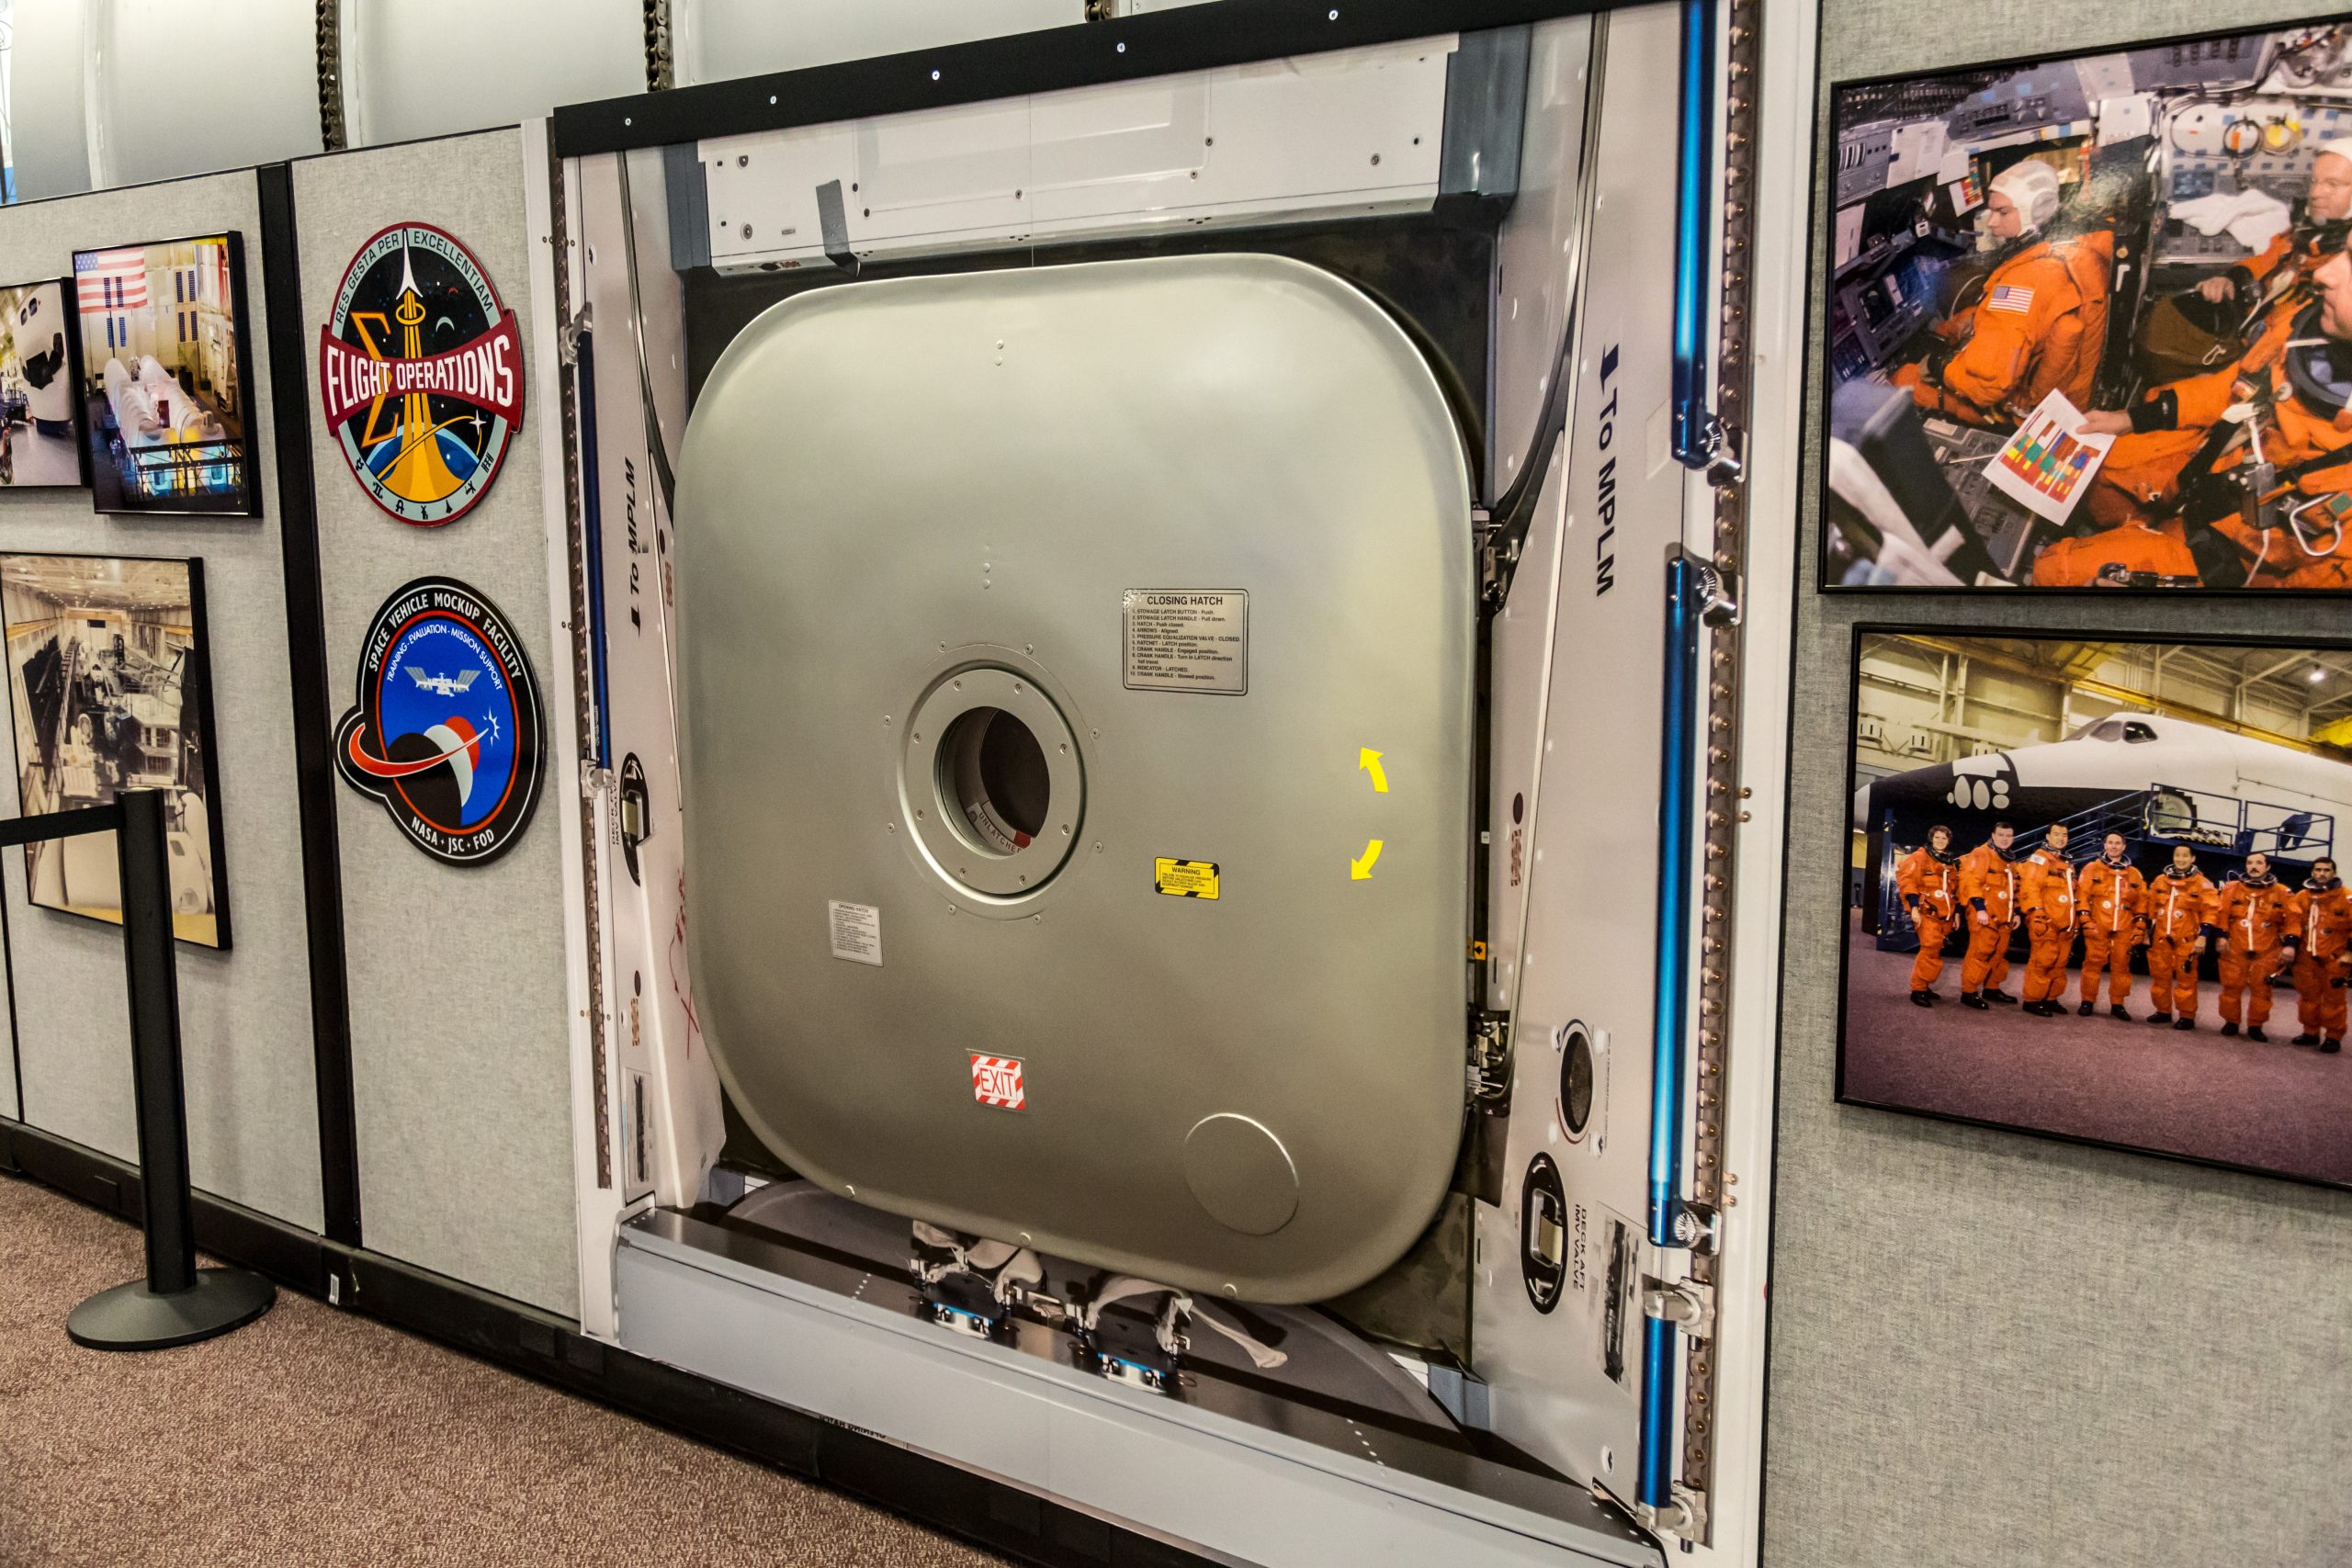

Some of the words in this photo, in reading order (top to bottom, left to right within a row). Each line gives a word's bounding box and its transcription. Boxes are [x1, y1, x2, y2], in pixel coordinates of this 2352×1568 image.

[336, 292, 349, 323] RES
[347, 249, 376, 290] GESTA
[378, 233, 400, 254] PER
[414, 231, 493, 311] EXCELLENTIAM
[327, 344, 390, 416] FLIGHT
[396, 334, 514, 407] OPERATIONS
[625, 457, 639, 555] MPLM
[1597, 457, 1616, 597] MPLM
[369, 627, 390, 671] SPACE
[389, 593, 428, 628] VEHICLE
[435, 592, 480, 620] MOCKUP
[483, 618, 521, 678] FACILITY
[1148, 596, 1187, 604] CLOSING
[1191, 597, 1223, 605] HATCH
[387, 642, 407, 682] TRAINING
[408, 625, 447, 644] EVALUATION
[451, 627, 481, 654] MISSION
[480, 650, 503, 690] SUPPORT
[412, 817, 437, 845] NASA
[448, 837, 465, 854] JSC
[473, 829, 494, 850] FOD
[1172, 867, 1201, 875] WARNING
[980, 1068, 1013, 1097] EXIT
